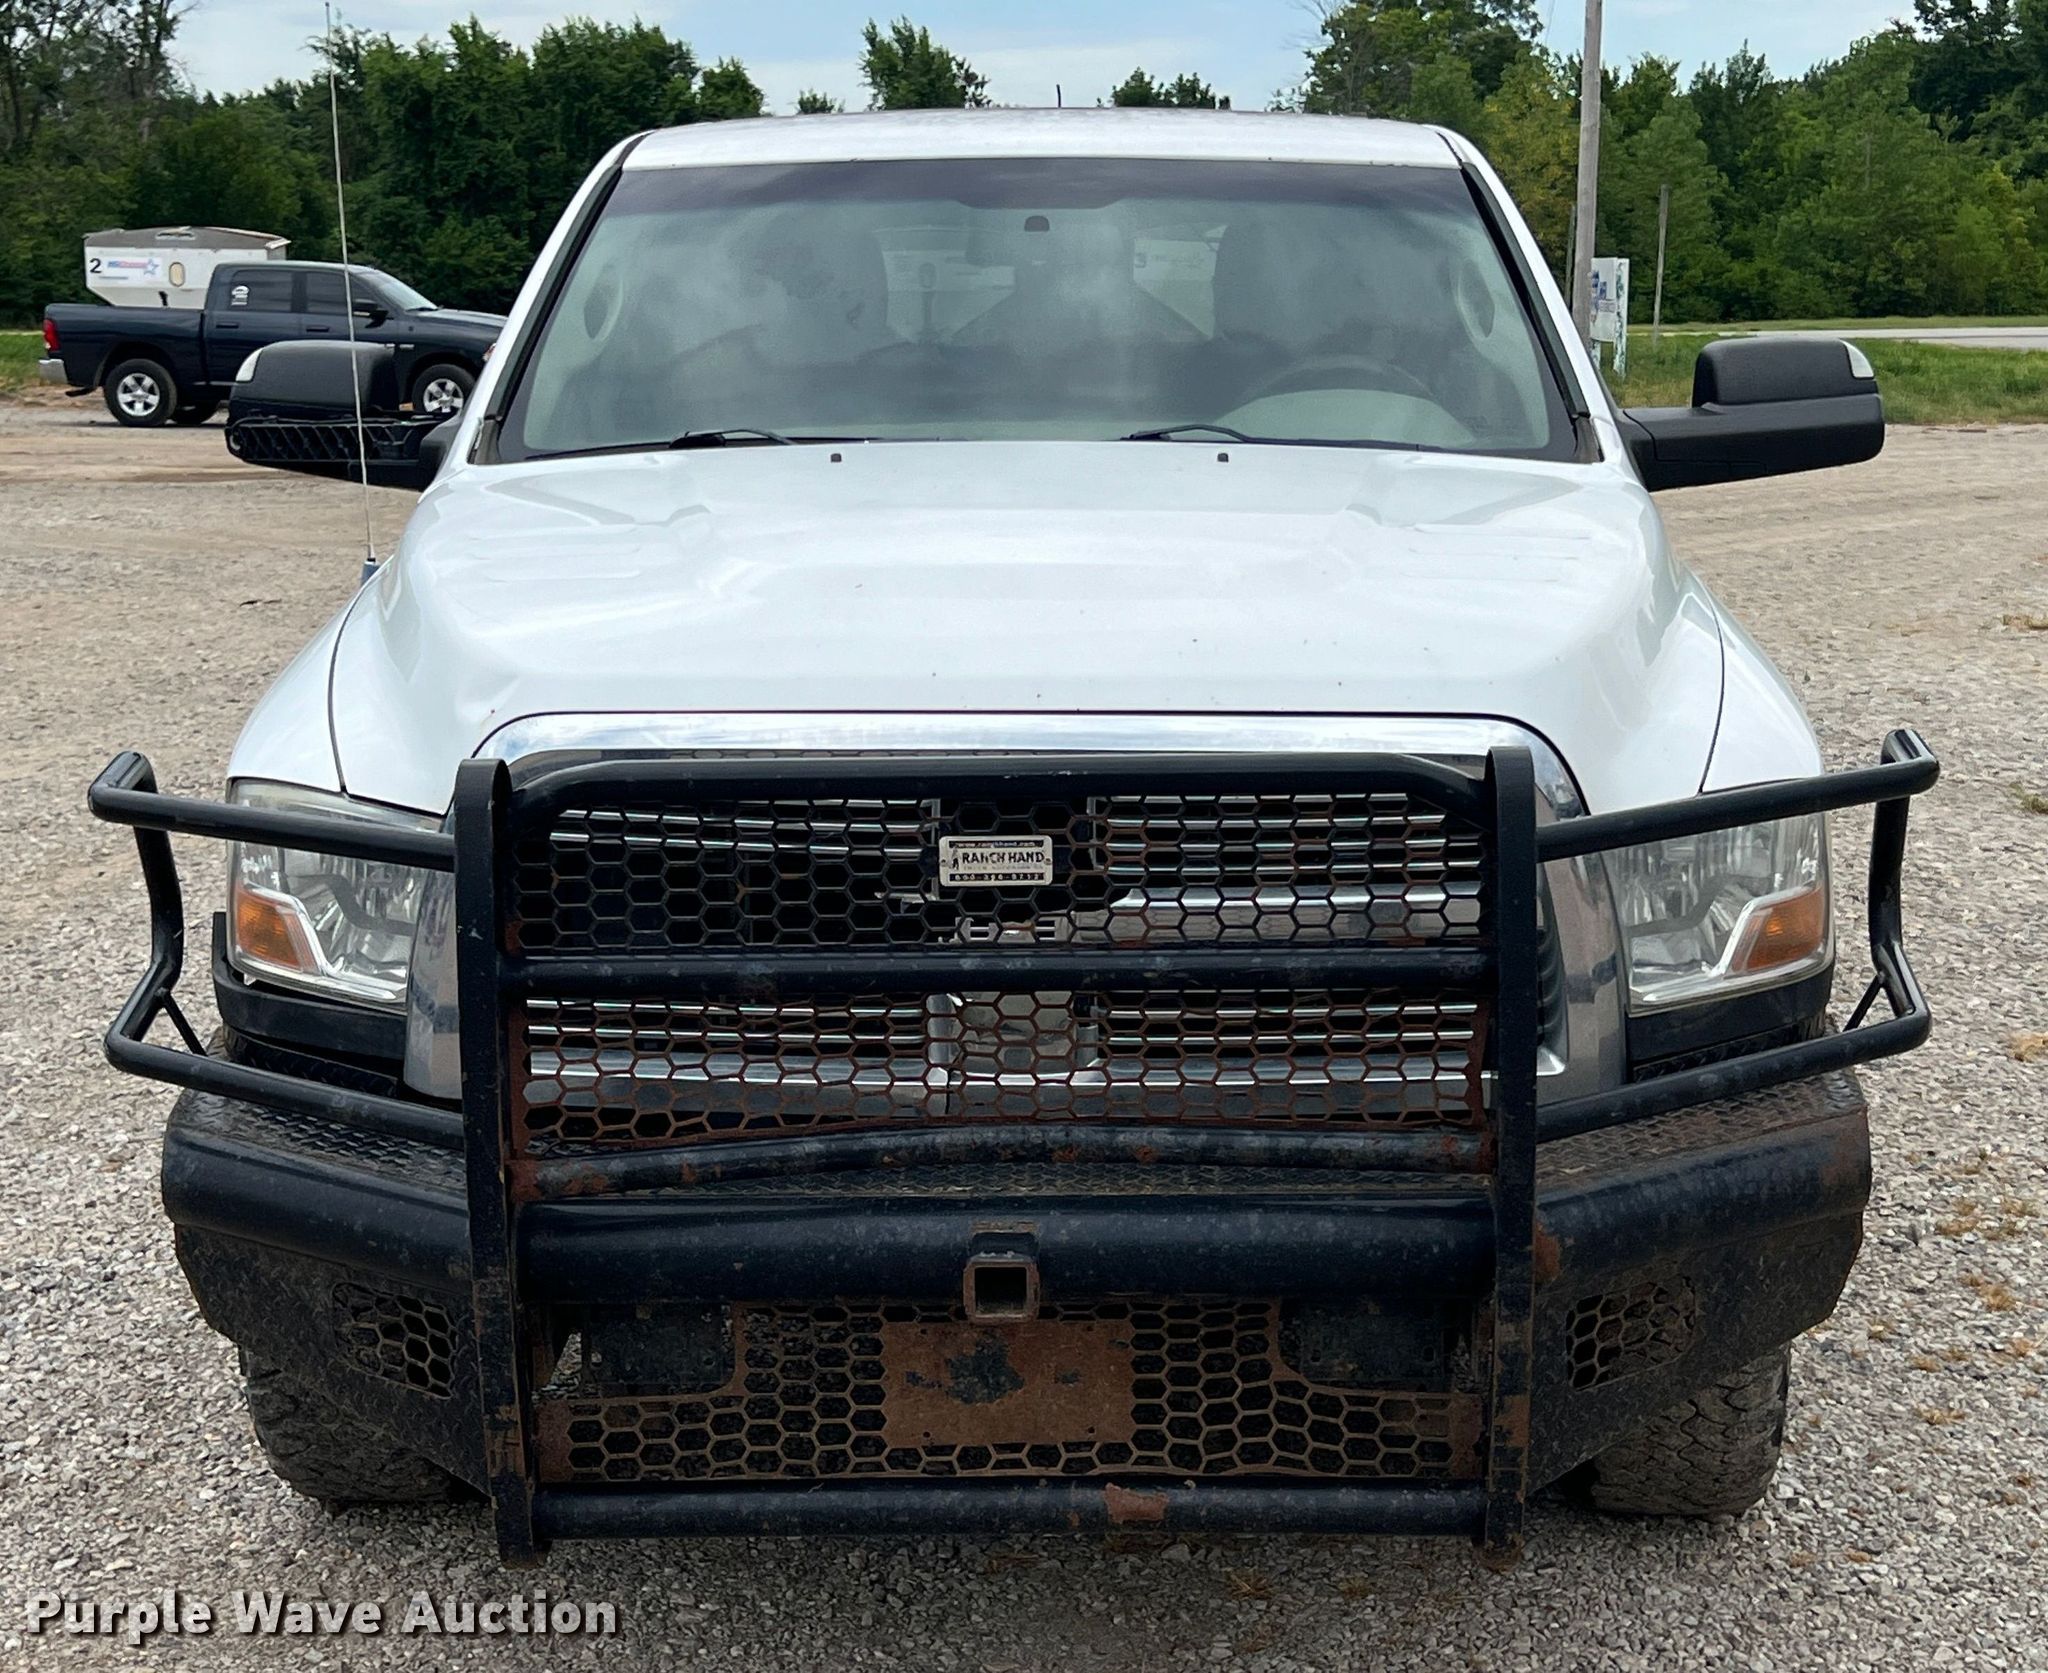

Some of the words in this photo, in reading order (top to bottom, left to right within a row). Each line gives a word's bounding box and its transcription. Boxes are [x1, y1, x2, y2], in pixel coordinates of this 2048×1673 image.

[89, 257, 102, 274] 2
[962, 852, 1005, 864] RANCH
[1008, 851, 1045, 864] HAND
